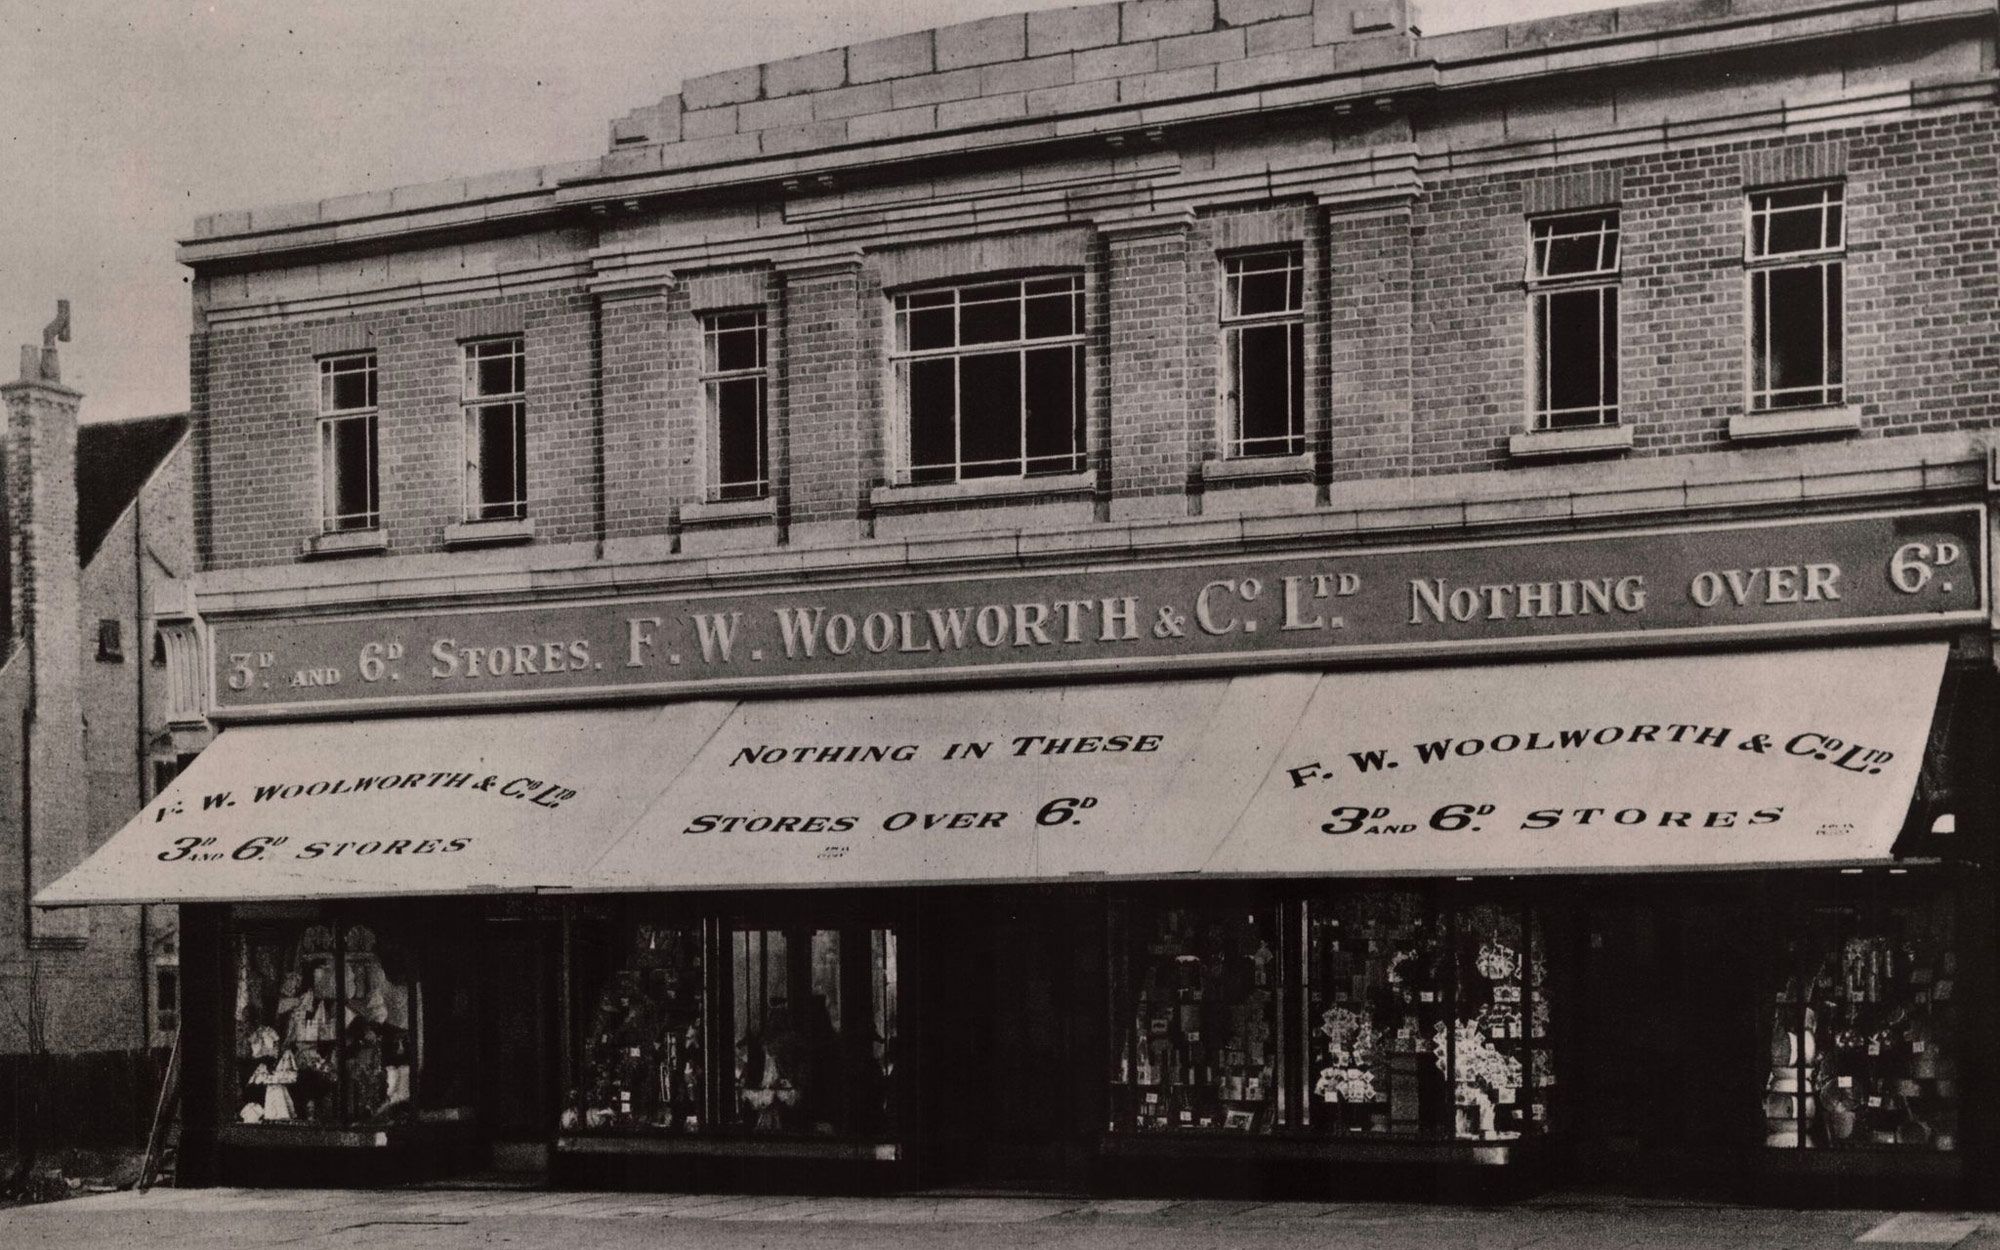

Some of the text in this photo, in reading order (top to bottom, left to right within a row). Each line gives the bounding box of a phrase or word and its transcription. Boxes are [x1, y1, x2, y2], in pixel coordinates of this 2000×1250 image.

[289, 669, 342, 688] AND
[626, 616, 682, 668] F.
[693, 612, 763, 662] W.
[775, 595, 1140, 660] WOOLWORTH
[1152, 604, 1185, 637] &
[1410, 574, 1647, 623] NOTHING
[1691, 562, 1840, 608] OVER
[728, 734, 1164, 768] NOTHING IN THESE
[1286, 762, 1334, 789] F.
[1348, 750, 1398, 772] W.
[1413, 723, 1733, 764] WOOLWORTH
[1738, 733, 1773, 754] &
[203, 792, 236, 811] W.
[253, 772, 472, 803] WOOLWORTH
[683, 813, 860, 835] STORES
[882, 811, 1009, 832] OVER
[1364, 824, 1418, 834] AND
[1520, 807, 1784, 830] STORES
[295, 837, 472, 859] STORES
